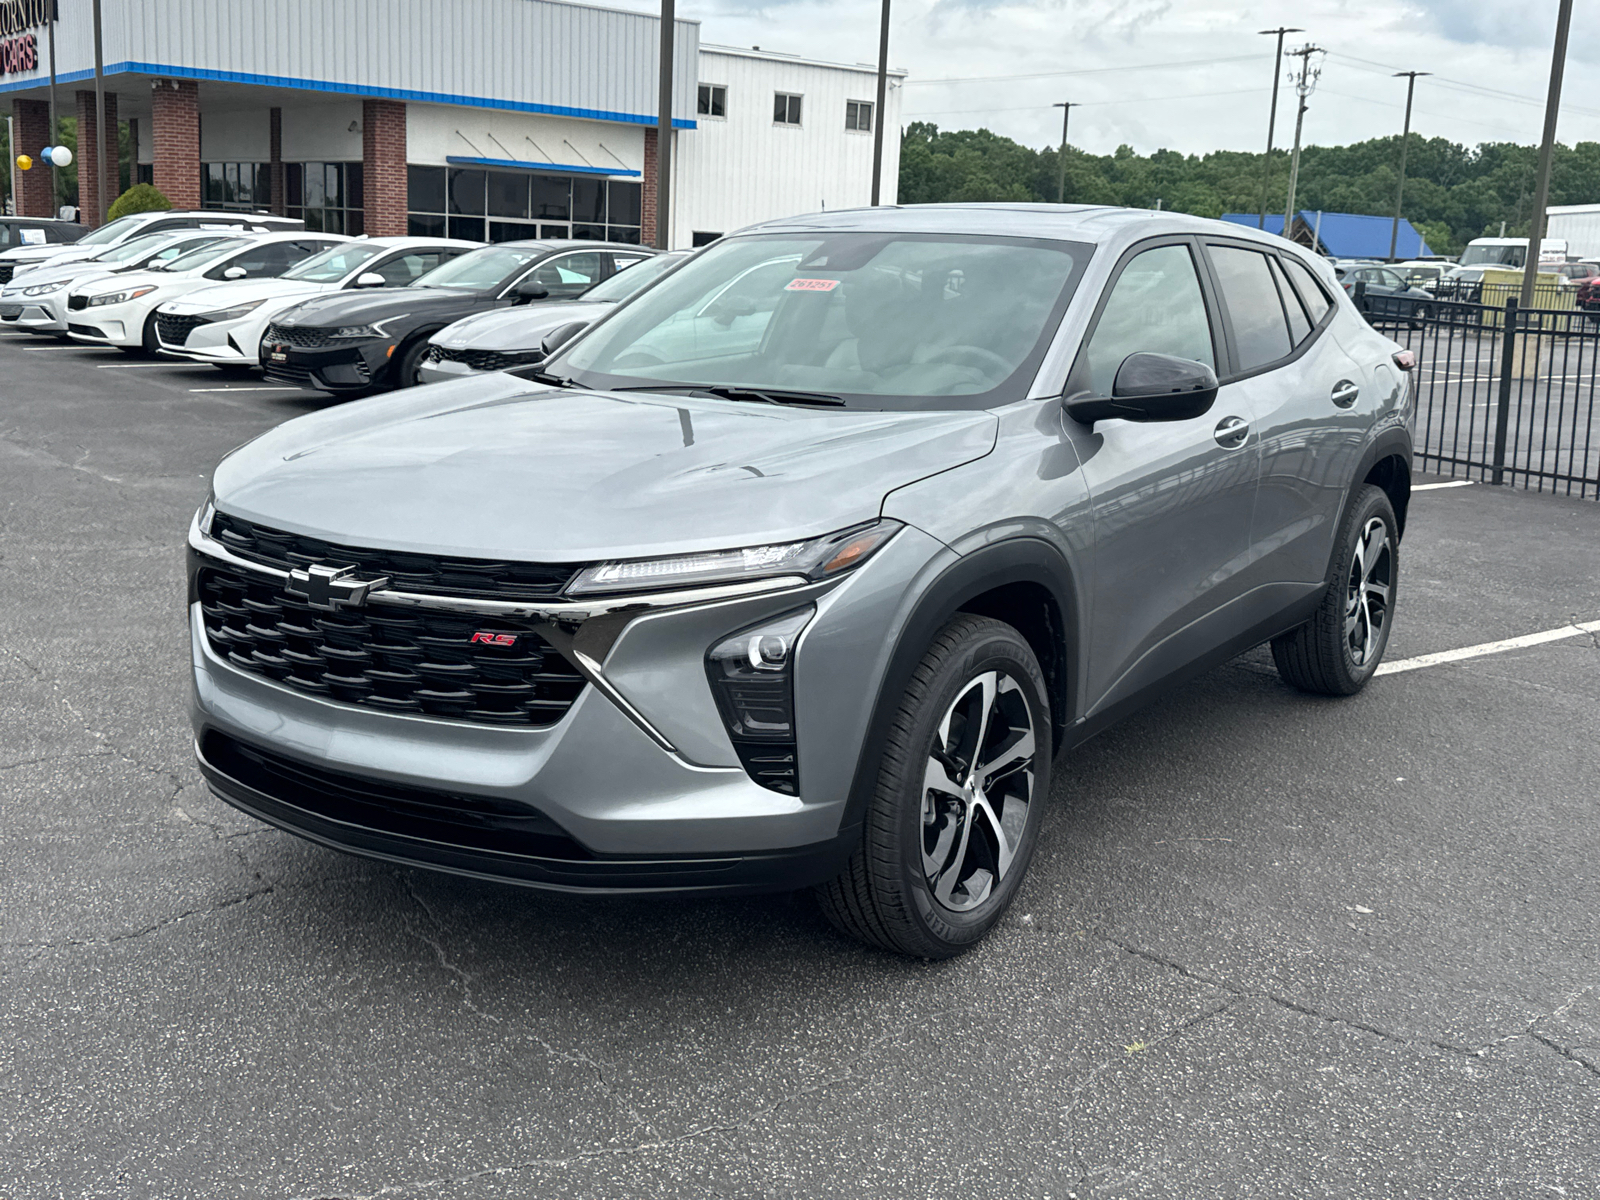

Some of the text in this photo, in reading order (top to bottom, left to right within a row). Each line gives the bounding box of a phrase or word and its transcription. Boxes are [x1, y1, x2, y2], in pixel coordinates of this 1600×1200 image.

[0, 0, 56, 35] ORNTO
[3, 34, 37, 73] CARS
[790, 280, 833, 289] 261251
[471, 632, 517, 646] RS
